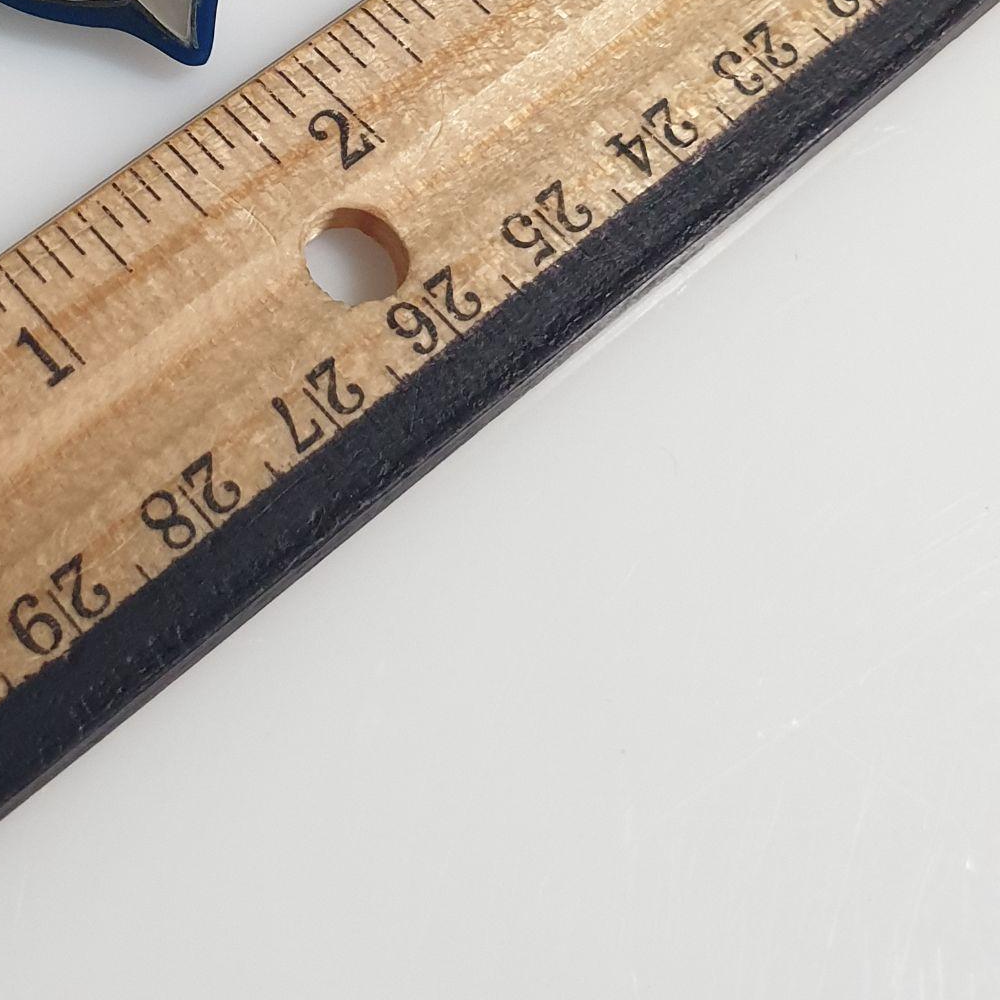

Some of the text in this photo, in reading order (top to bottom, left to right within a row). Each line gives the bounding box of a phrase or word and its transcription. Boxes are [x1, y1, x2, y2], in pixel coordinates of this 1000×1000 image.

[712, 21, 798, 96] 23
[309, 109, 372, 169] 2
[606, 98, 699, 176] 24
[501, 181, 593, 266] 25
[387, 266, 481, 354] 26
[16, 326, 75, 387] 1
[271, 357, 365, 453] 27
[141, 453, 242, 550] 28
[8, 554, 111, 654] 29
